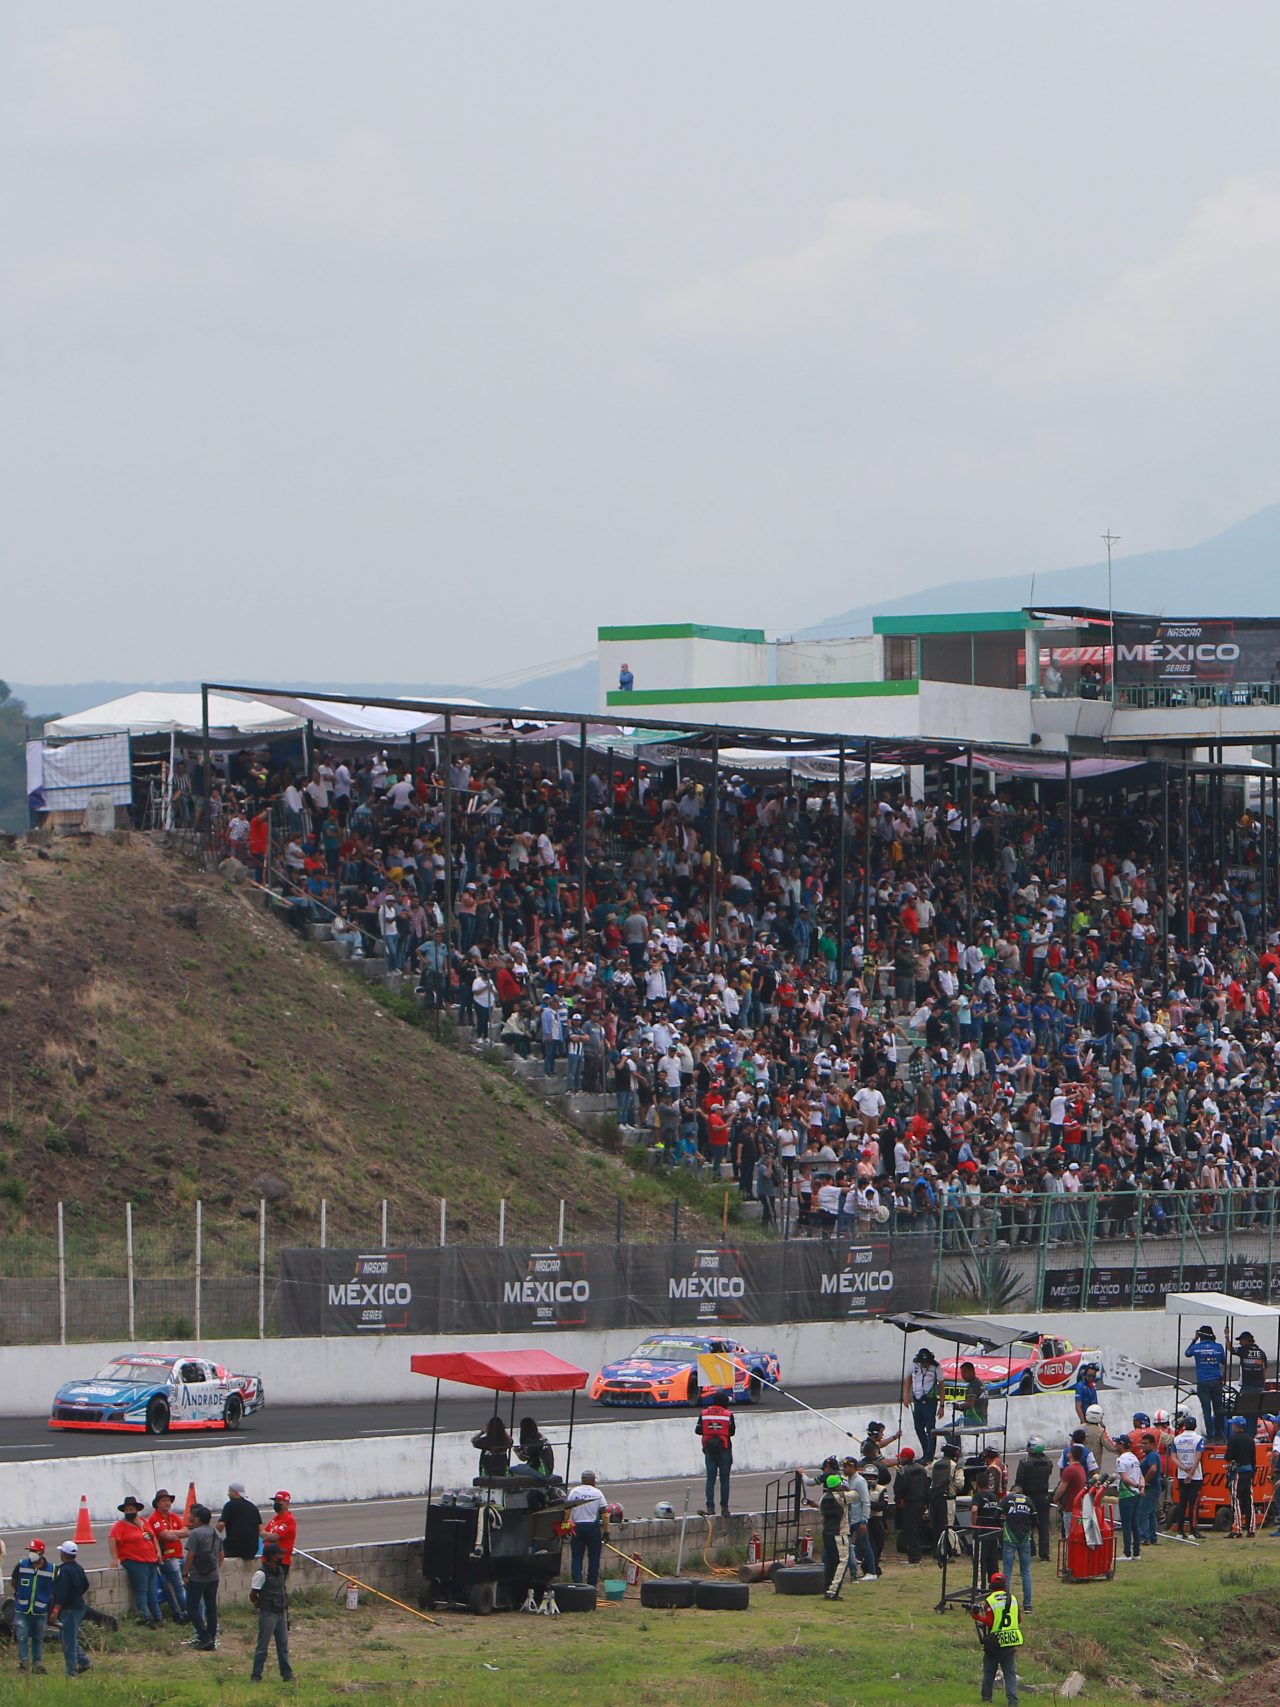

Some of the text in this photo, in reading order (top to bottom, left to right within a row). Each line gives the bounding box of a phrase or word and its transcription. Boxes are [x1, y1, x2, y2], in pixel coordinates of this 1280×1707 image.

[1166, 627, 1202, 638] NASCAR
[1038, 645, 1110, 662] ECATE
[1117, 639, 1240, 661] MÉXICO
[1165, 664, 1191, 673] SERIES
[534, 1260, 561, 1272] NASCAR
[668, 1271, 745, 1298] MÉXICO
[820, 1267, 894, 1294] MÉXICO
[1160, 1281, 1190, 1293] MÉXCO
[328, 1278, 412, 1305] MÉXICO
[503, 1276, 590, 1303] MÉXICO
[1125, 1283, 1155, 1294] MXICO
[361, 1310, 383, 1320] SERIES
[949, 1361, 988, 1370] NTO
[1044, 1363, 1063, 1375] NIETO
[181, 1385, 224, 1409] ANDRADE
[997, 1630, 1020, 1645] PRENSA
